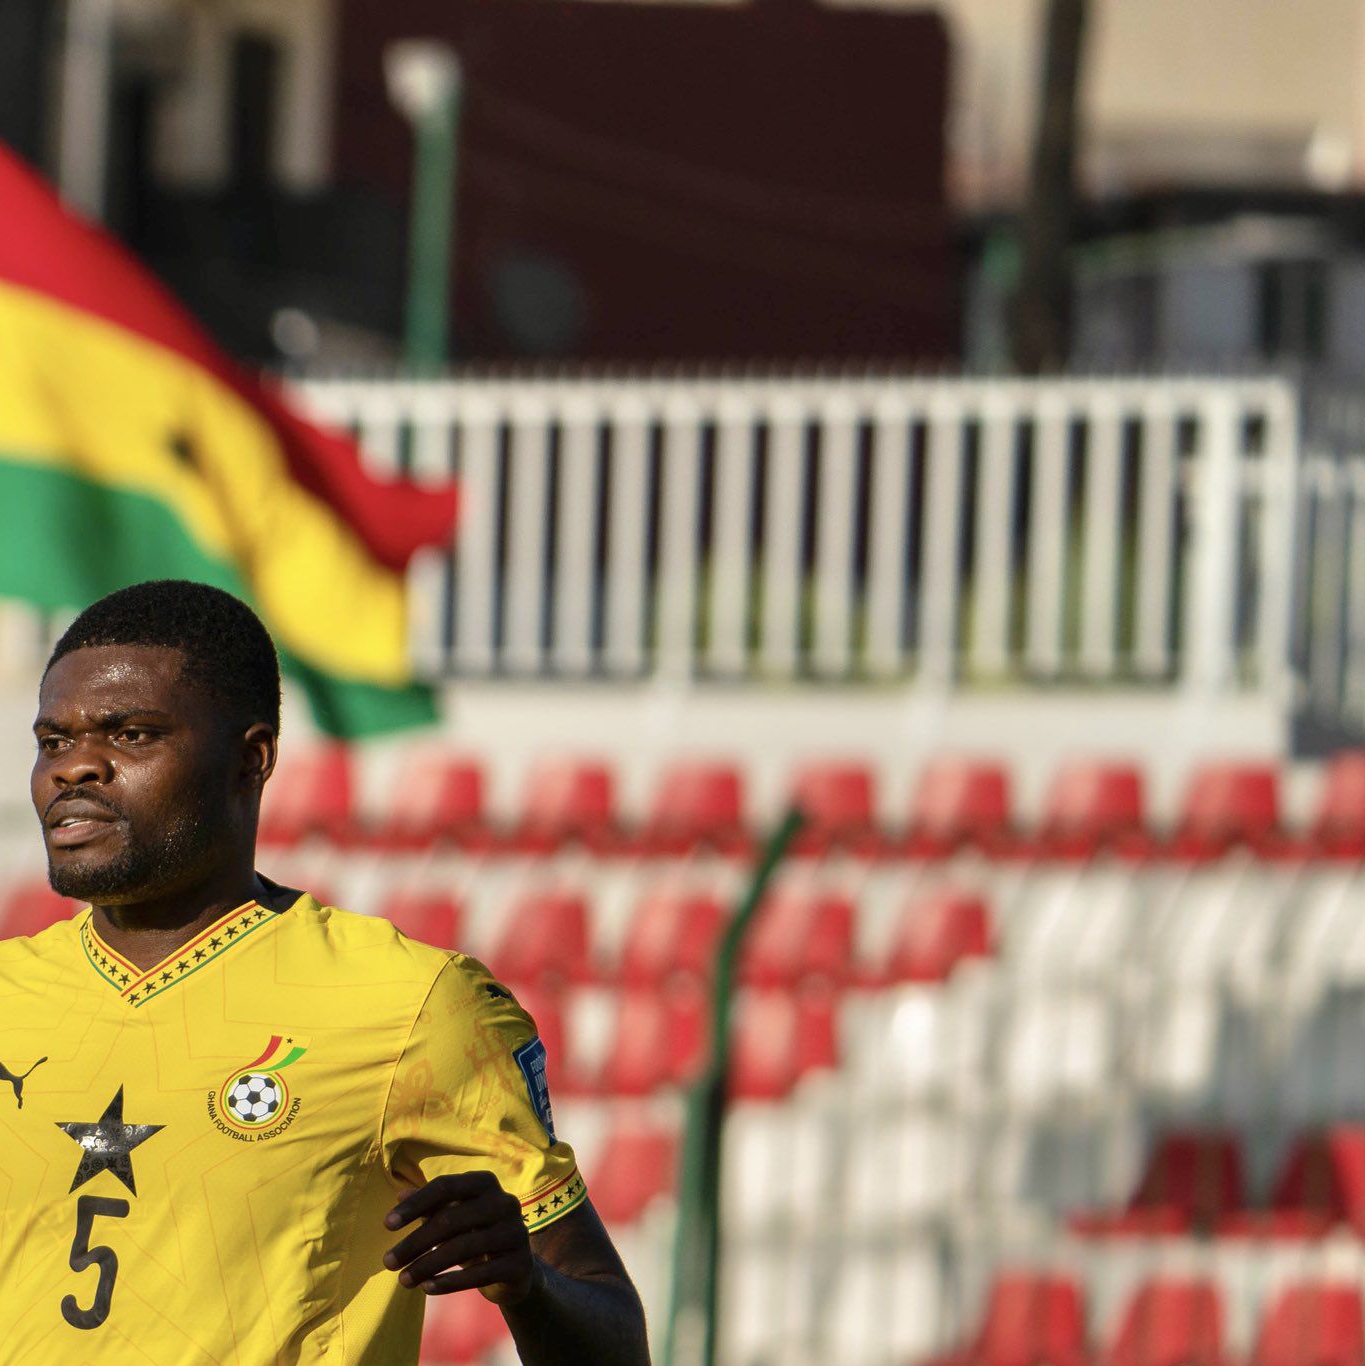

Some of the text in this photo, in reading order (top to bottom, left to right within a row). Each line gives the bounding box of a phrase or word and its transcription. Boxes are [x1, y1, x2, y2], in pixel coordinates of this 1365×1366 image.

[207, 1090, 302, 1142] GHANA FOOTBALL ASSOCIATION
[60, 1195, 130, 1330] 5
